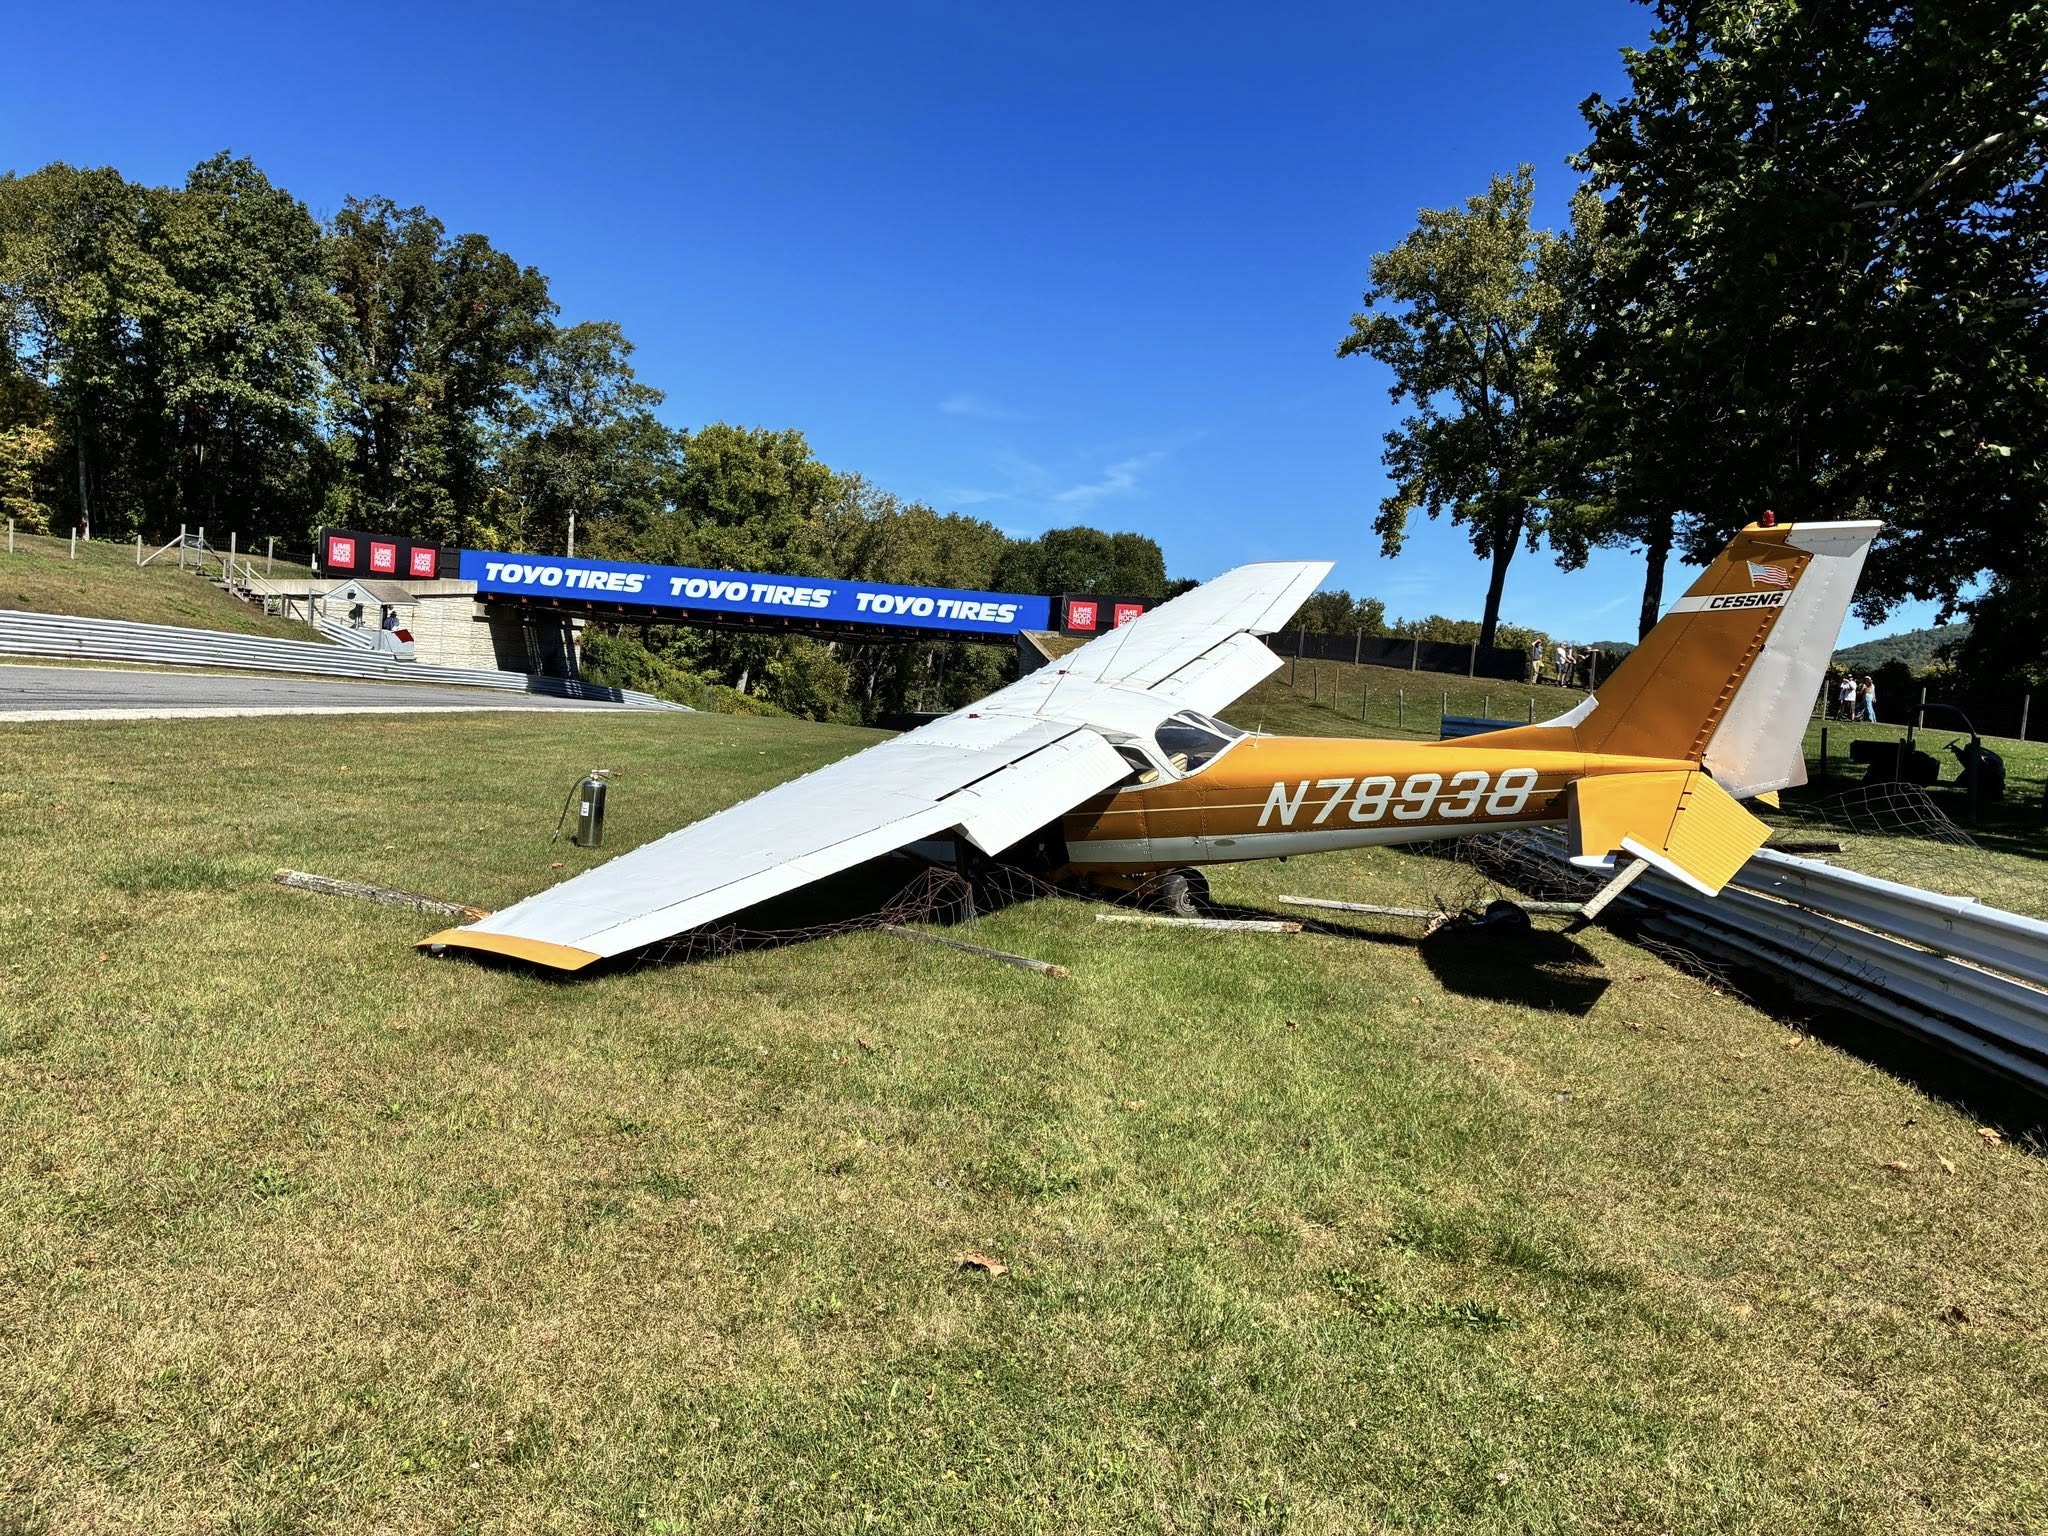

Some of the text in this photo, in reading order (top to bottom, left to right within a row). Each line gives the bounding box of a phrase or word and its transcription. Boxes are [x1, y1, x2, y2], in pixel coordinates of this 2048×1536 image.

[333, 542, 351, 550] LIME
[333, 548, 351, 556] ROCK
[374, 547, 392, 555] LIME
[332, 554, 350, 563] PARK
[374, 553, 392, 562] ROCK
[414, 552, 432, 560] LIME
[374, 559, 391, 568] PARK
[414, 558, 432, 566] ROCK
[413, 564, 431, 572] PARK
[485, 562, 646, 593] TOYO TIRES
[669, 577, 832, 608] TOYO TIRES
[1709, 593, 1784, 609] CESSNA
[856, 592, 1018, 624] TOYO TIRES
[1257, 767, 1539, 828] N78938
